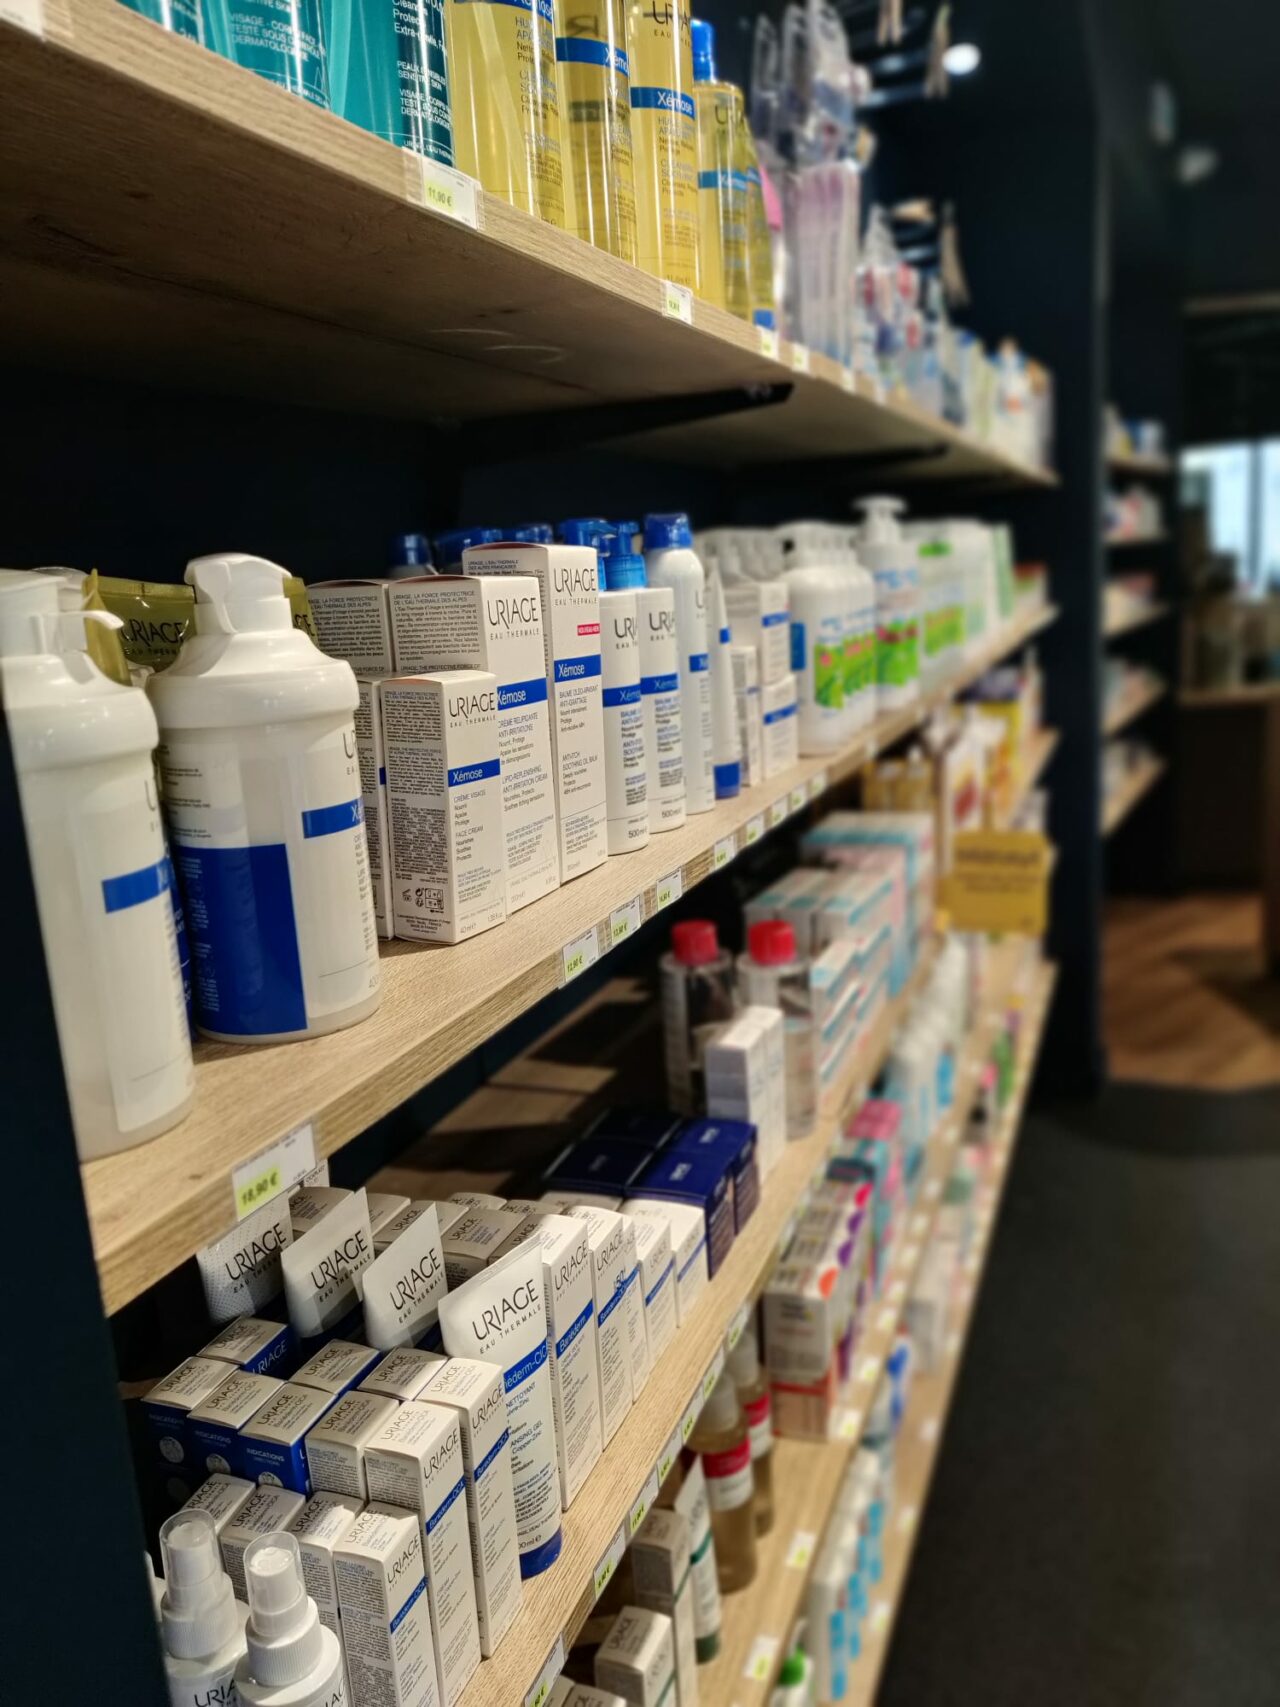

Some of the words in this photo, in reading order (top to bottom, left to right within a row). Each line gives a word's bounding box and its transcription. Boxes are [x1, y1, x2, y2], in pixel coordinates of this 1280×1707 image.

[428, 187, 446, 204] 11,90
[447, 196, 453, 207] €
[554, 568, 597, 597] URIAGE
[487, 598, 539, 629] URIAGE
[507, 628, 540, 638] THERMALE
[558, 663, 585, 678] Xémose
[448, 692, 496, 719] URIAGE
[497, 689, 527, 705] Xémose
[466, 715, 496, 725] THERMALE
[452, 768, 483, 784] Xémose
[225, 1222, 287, 1281] URIAGE
[311, 1230, 368, 1290] URIAGE
[597, 1229, 623, 1271] URIAGE
[319, 1288, 334, 1303] EAU
[336, 1254, 371, 1287] THERMALE
[390, 1248, 441, 1311] URIAGE
[554, 1240, 588, 1291] URIAGE
[233, 1279, 250, 1294] EAU
[398, 1309, 412, 1324] EAU
[413, 1272, 444, 1307] THERMALE
[472, 1279, 539, 1341] URIAGE
[480, 1339, 496, 1354] EAU
[499, 1304, 541, 1339] THERMALE
[304, 1348, 340, 1376] URIAGE
[375, 1355, 407, 1382] URIAGE
[504, 1345, 547, 1389] iéderm-CIC
[160, 1366, 195, 1392] URIAGE
[431, 1365, 461, 1393] URIAGE
[206, 1380, 242, 1409] URIAGE
[256, 1394, 293, 1425] URIAGE
[472, 1384, 503, 1429] URIAGE
[320, 1400, 354, 1430] URIAGE
[381, 1410, 413, 1440] URIAGE
[246, 1448, 285, 1462] INDICATIONS
[424, 1428, 459, 1479] URIAGE
[232, 1494, 265, 1527] URIAGE
[292, 1500, 323, 1533] URIAGE
[344, 1509, 377, 1543] URIAGE
[387, 1534, 420, 1584] URIAGE
[194, 1678, 237, 1707] URIA
